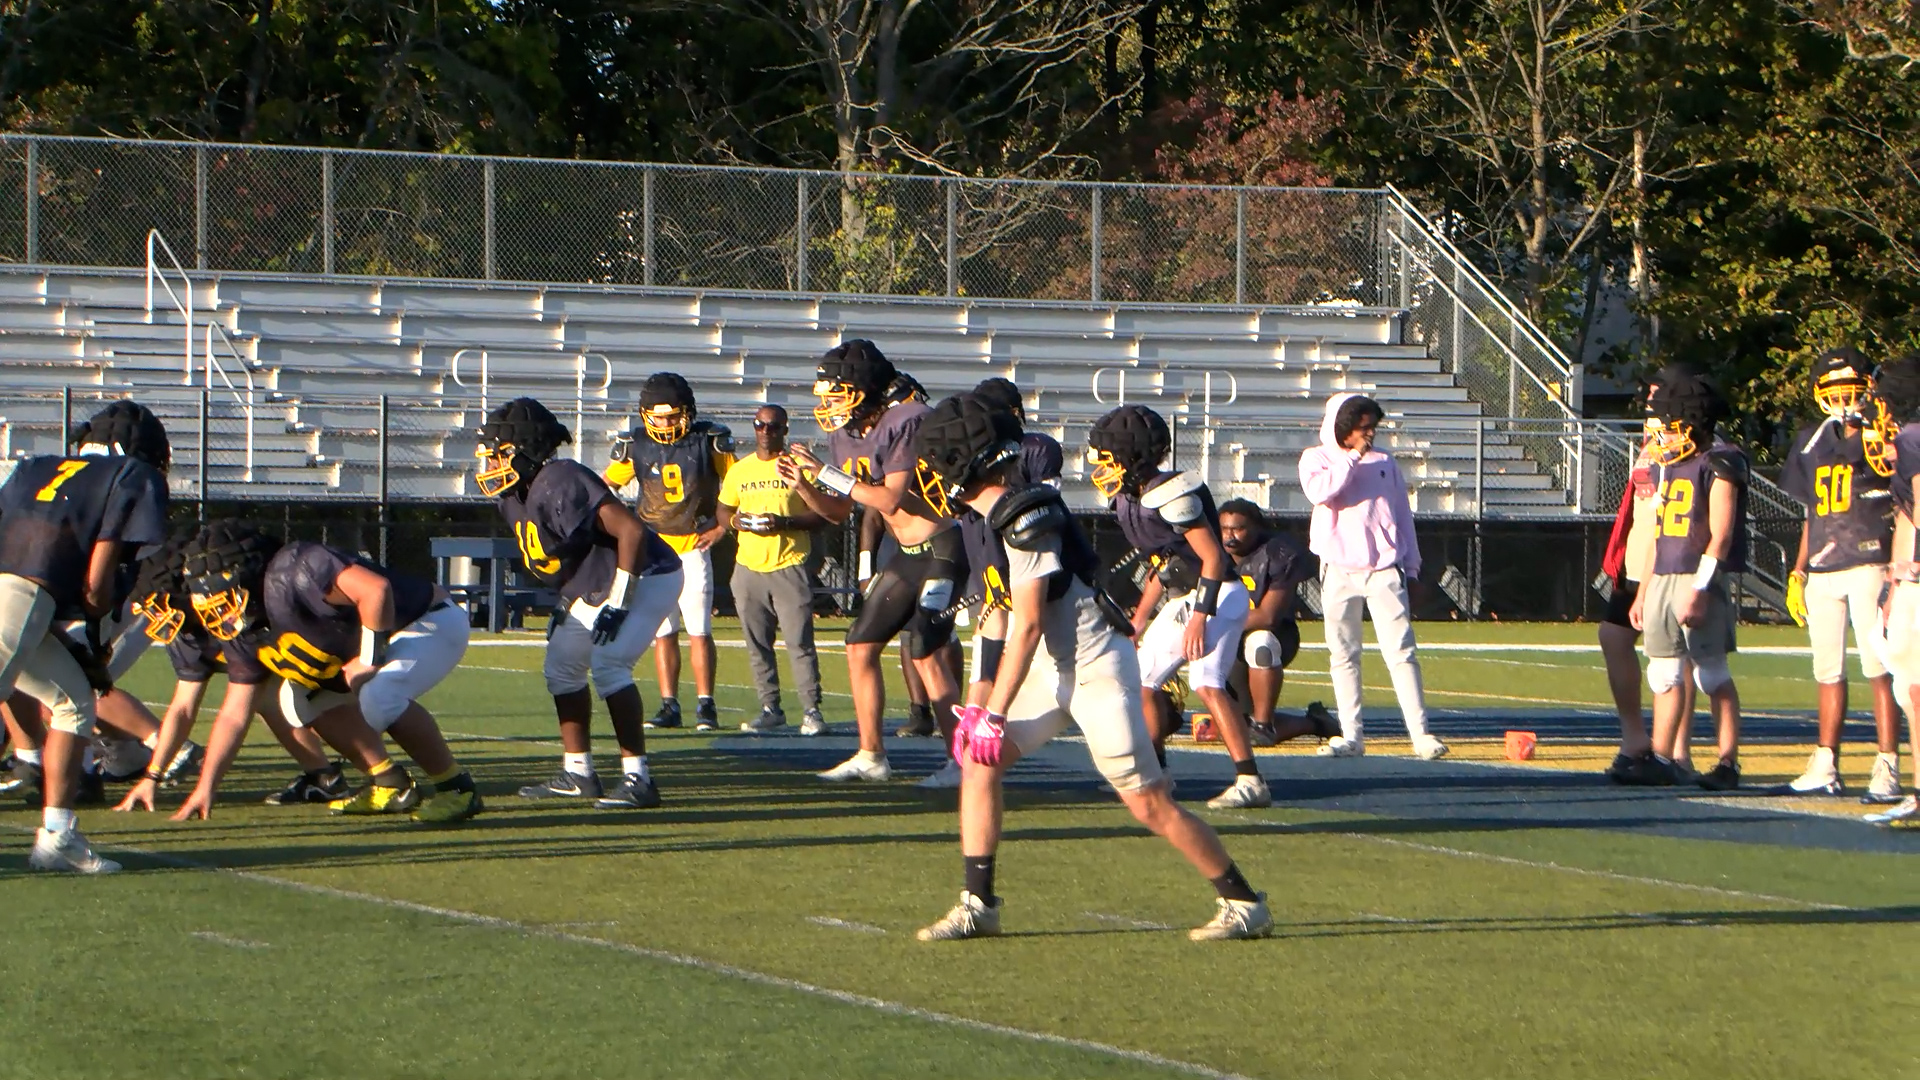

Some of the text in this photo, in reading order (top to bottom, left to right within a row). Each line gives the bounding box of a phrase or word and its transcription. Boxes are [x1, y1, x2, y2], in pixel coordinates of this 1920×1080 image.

[35, 460, 90, 502] 7
[661, 463, 685, 503] 9
[741, 480, 789, 492] MARION
[1815, 464, 1853, 516] 50
